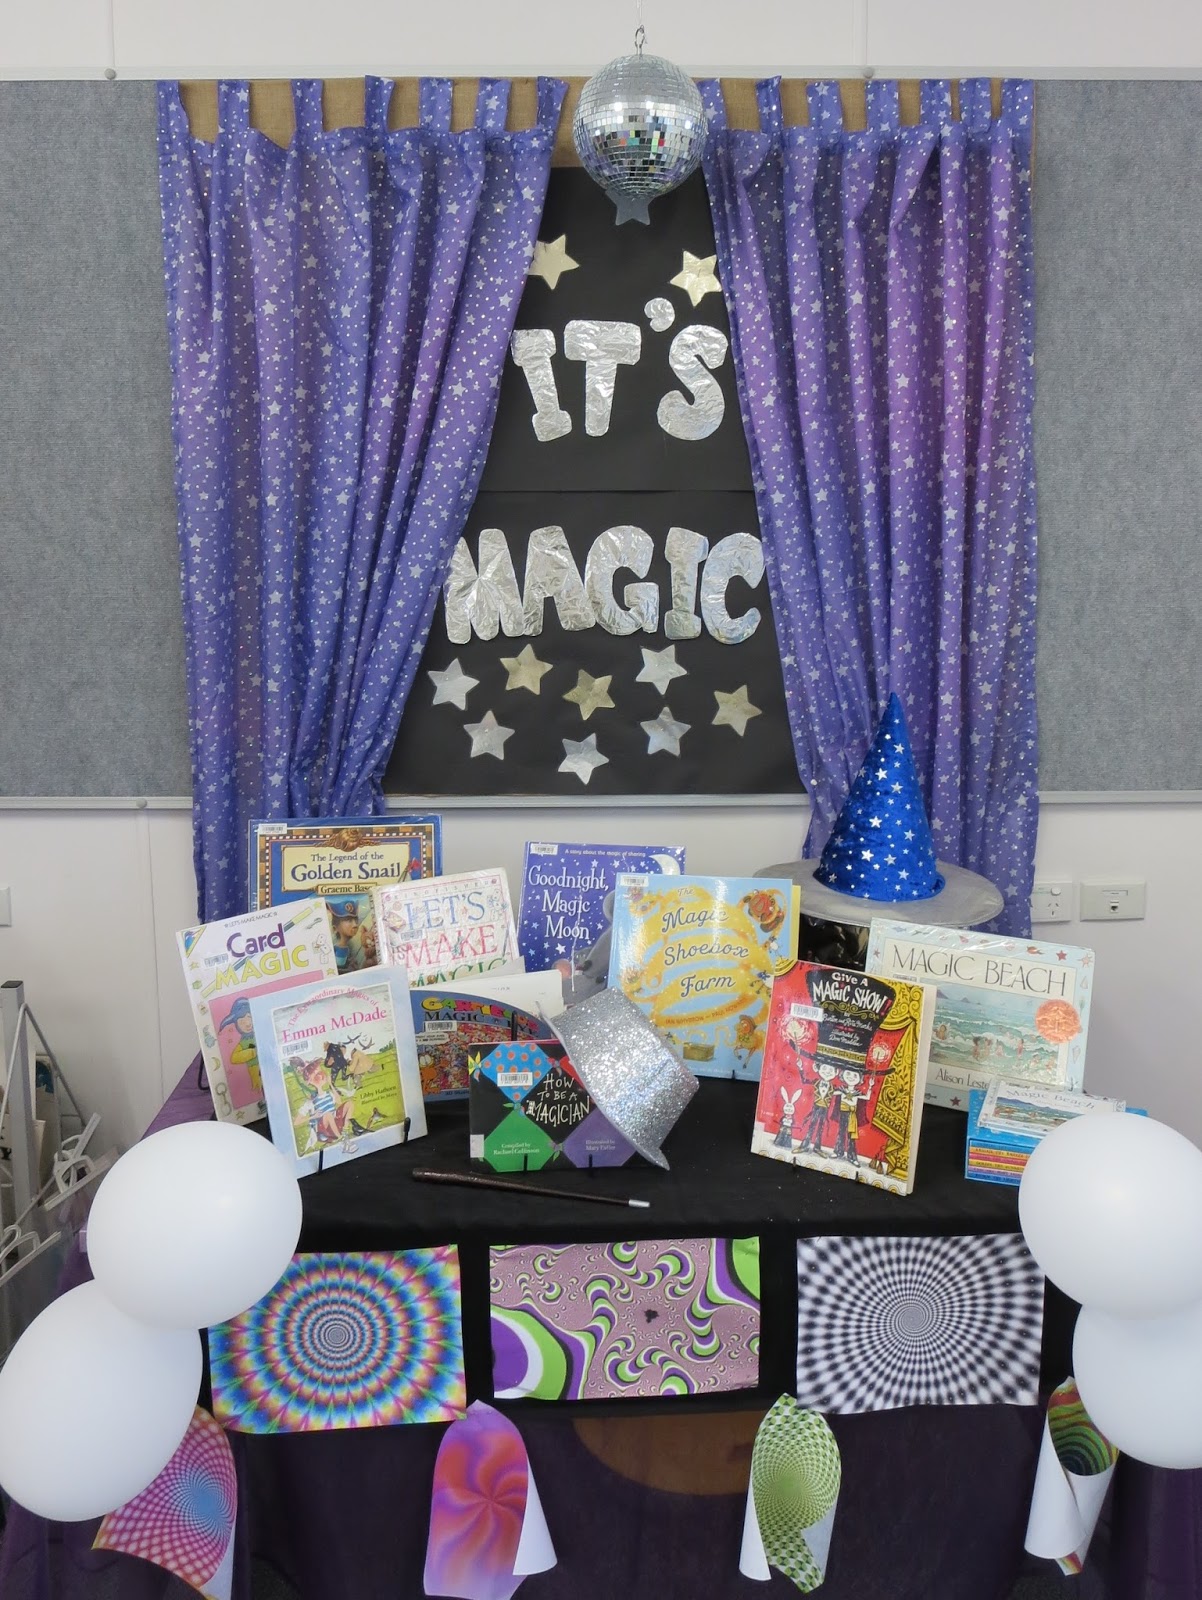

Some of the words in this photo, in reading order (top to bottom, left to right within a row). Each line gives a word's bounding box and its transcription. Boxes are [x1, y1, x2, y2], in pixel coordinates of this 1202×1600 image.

[511, 298, 728, 441] IT'S
[443, 525, 765, 644] MAGIC
[311, 854, 326, 862] The
[329, 853, 358, 863] Legend
[360, 852, 369, 861] of
[371, 852, 384, 860] the
[291, 864, 352, 881] Golden
[358, 862, 400, 880] Snail
[529, 865, 609, 892] Goodnight,
[321, 885, 352, 893] Graeme
[542, 889, 591, 916] Magic
[678, 888, 695, 897] The
[404, 891, 485, 931] LET'S
[661, 907, 730, 933] Magic
[226, 923, 286, 958] Card
[545, 914, 590, 940] Moon
[407, 925, 498, 969] MAKE
[664, 937, 749, 966] Shoebox
[215, 945, 310, 990] MAGIC
[893, 944, 975, 982] MAGIC
[985, 960, 1066, 996] BEACH
[681, 974, 736, 998] Farm
[852, 987, 893, 1016] SHOW!
[282, 1024, 327, 1043] Emma
[331, 1006, 388, 1030] McDade
[425, 1011, 483, 1021] MAGIC
[935, 1068, 964, 1084] Alison
[553, 1091, 567, 1101] BE
[568, 1092, 578, 1101] A
[1006, 1090, 1047, 1100] Magic
[1055, 1095, 1095, 1109] Beach
[526, 1095, 590, 1127] MAGICIAN
